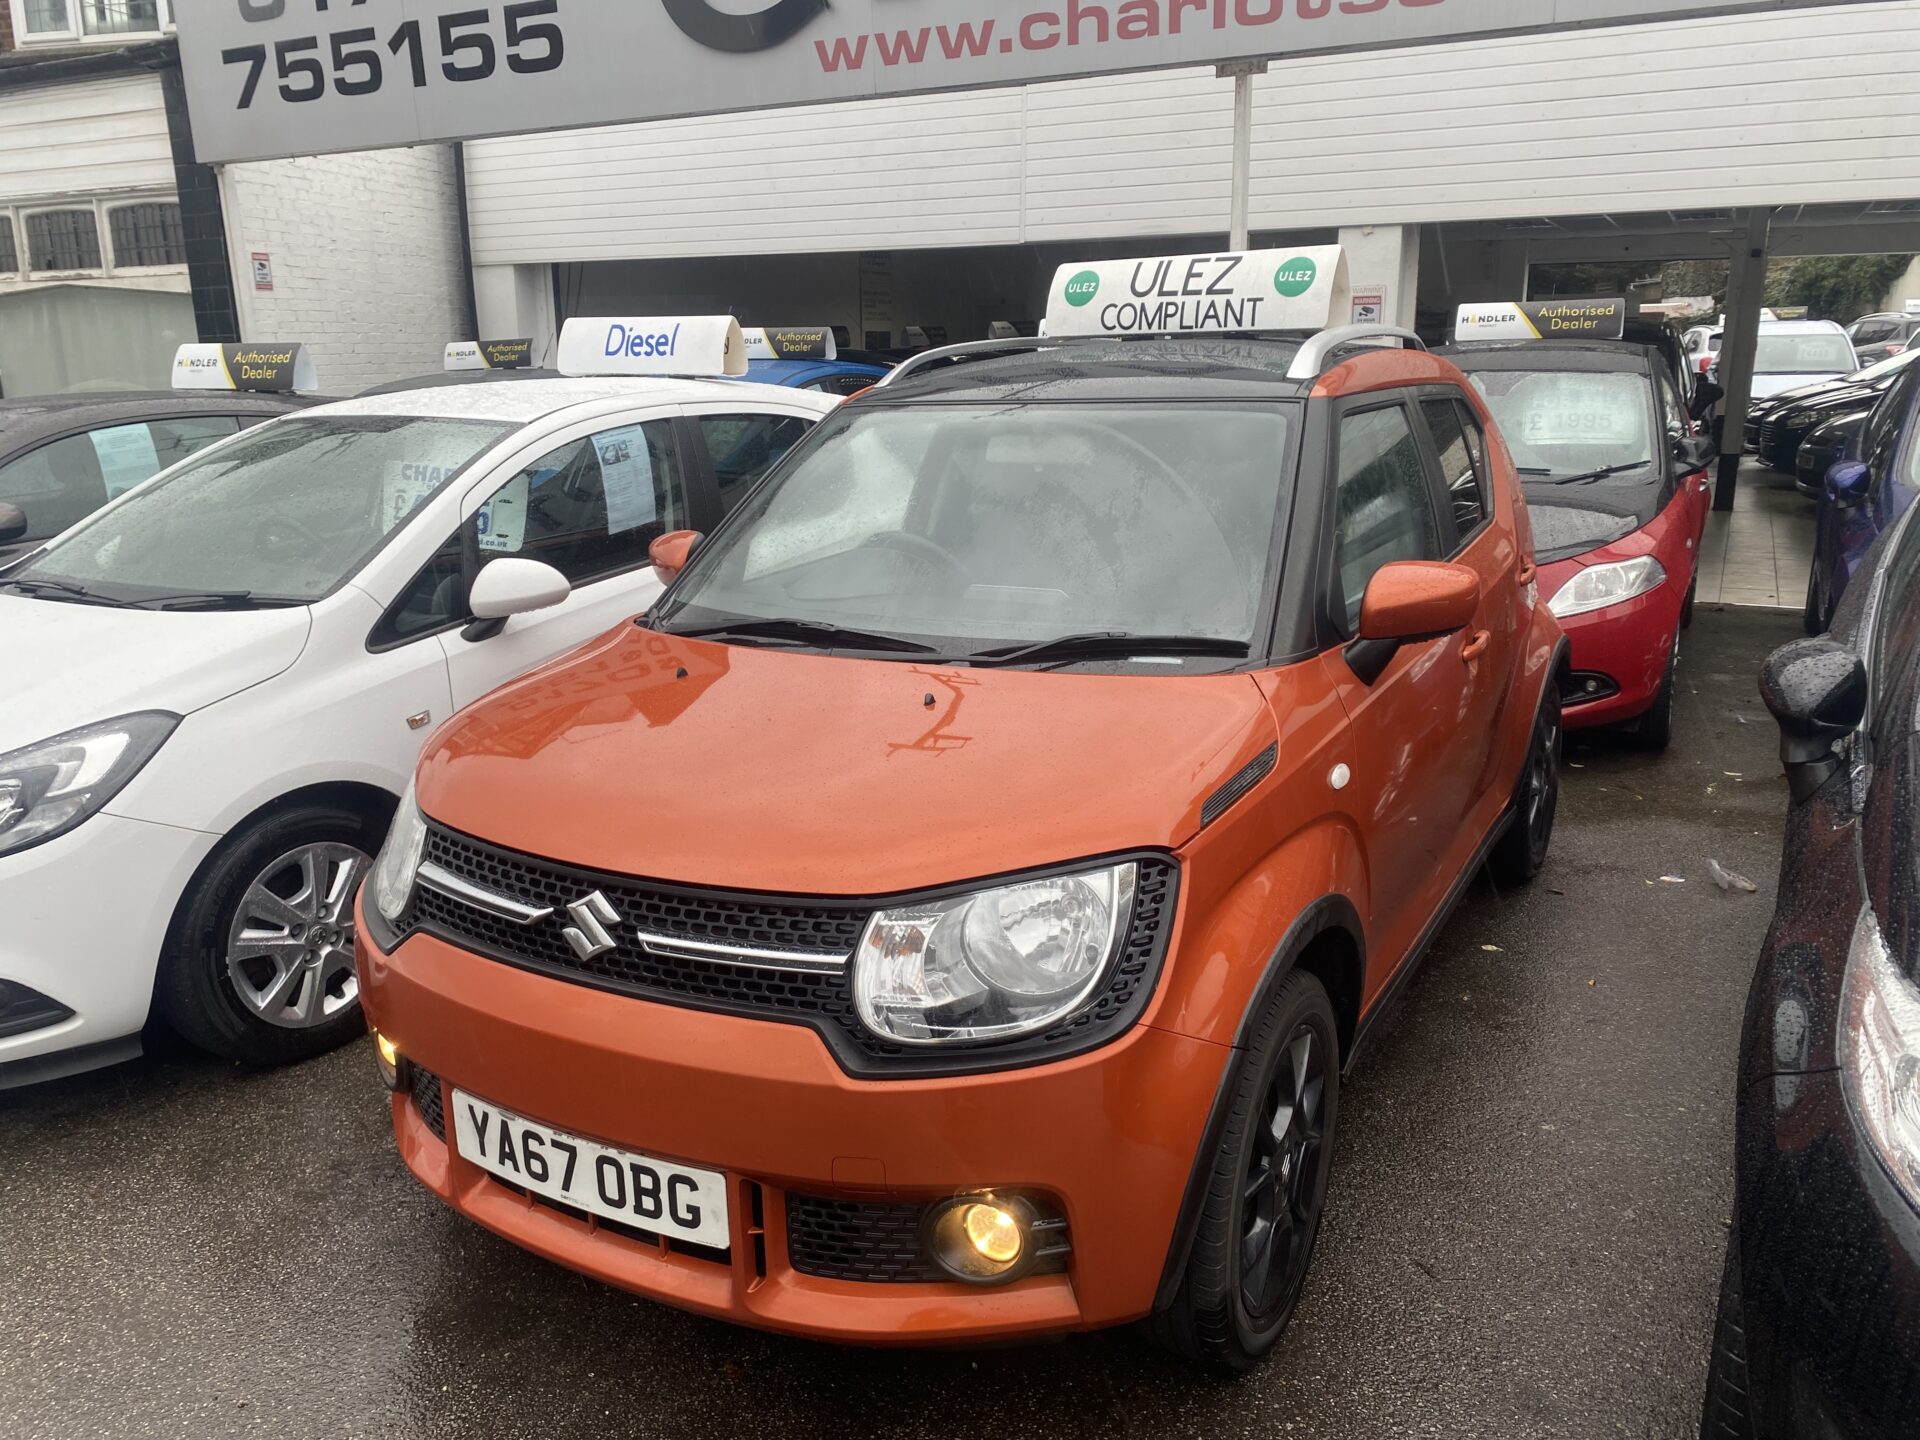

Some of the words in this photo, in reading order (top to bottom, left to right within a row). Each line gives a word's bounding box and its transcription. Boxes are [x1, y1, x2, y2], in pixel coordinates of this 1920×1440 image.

[814, 0, 1447, 73] www.chario
[222, 0, 564, 109] 755155
[1130, 256, 1243, 298] ULEZ
[1279, 270, 1312, 282] ULEZ
[1068, 282, 1096, 293] ULEZ
[1101, 297, 1264, 331] COMPLIANT
[1538, 304, 1615, 317] Authorised
[1551, 318, 1598, 330] Dealer
[605, 323, 680, 357] Diesel
[776, 331, 822, 341] Authorised
[487, 343, 528, 352] Authorised
[783, 342, 812, 351] Dealer
[234, 350, 292, 363] Authorised
[493, 353, 519, 361] Dealer
[241, 366, 277, 379] Dealer
[468, 1103, 578, 1193] YA67
[595, 1154, 701, 1229] OBG
